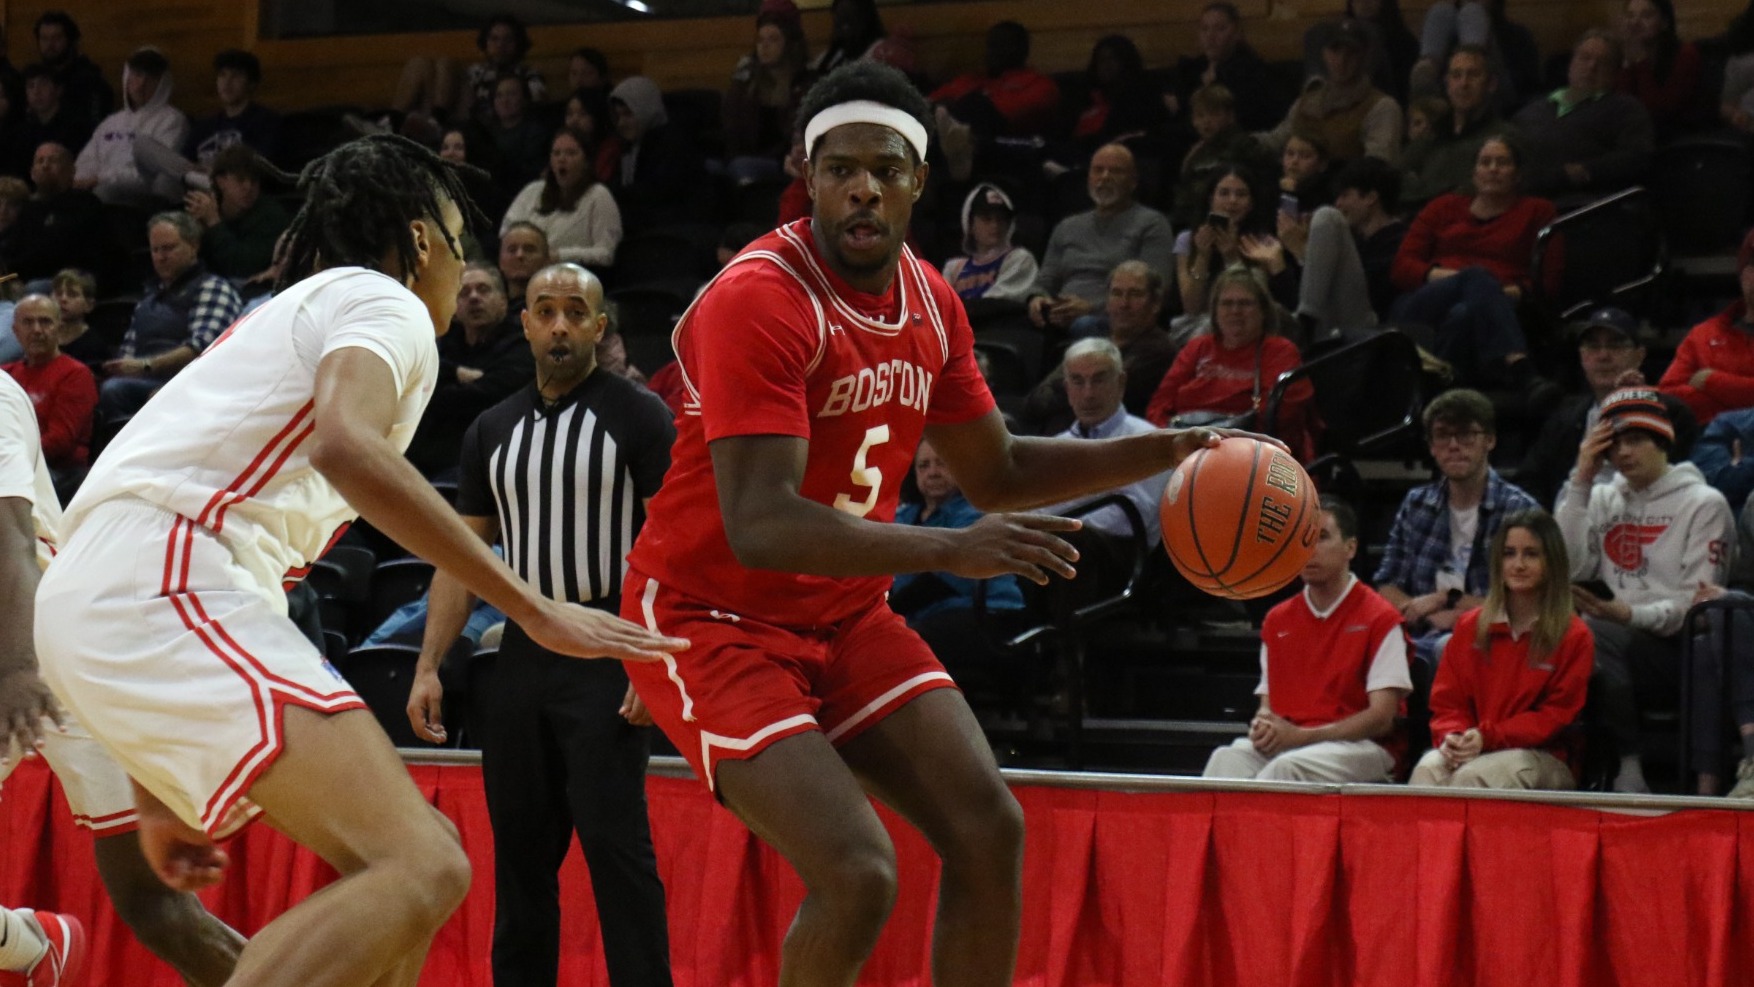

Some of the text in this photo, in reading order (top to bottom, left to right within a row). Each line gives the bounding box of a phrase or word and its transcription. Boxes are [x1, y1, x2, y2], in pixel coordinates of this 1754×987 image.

[817, 359, 933, 418] BOSTON
[833, 423, 891, 518] 5
[1256, 496, 1292, 544] THE
